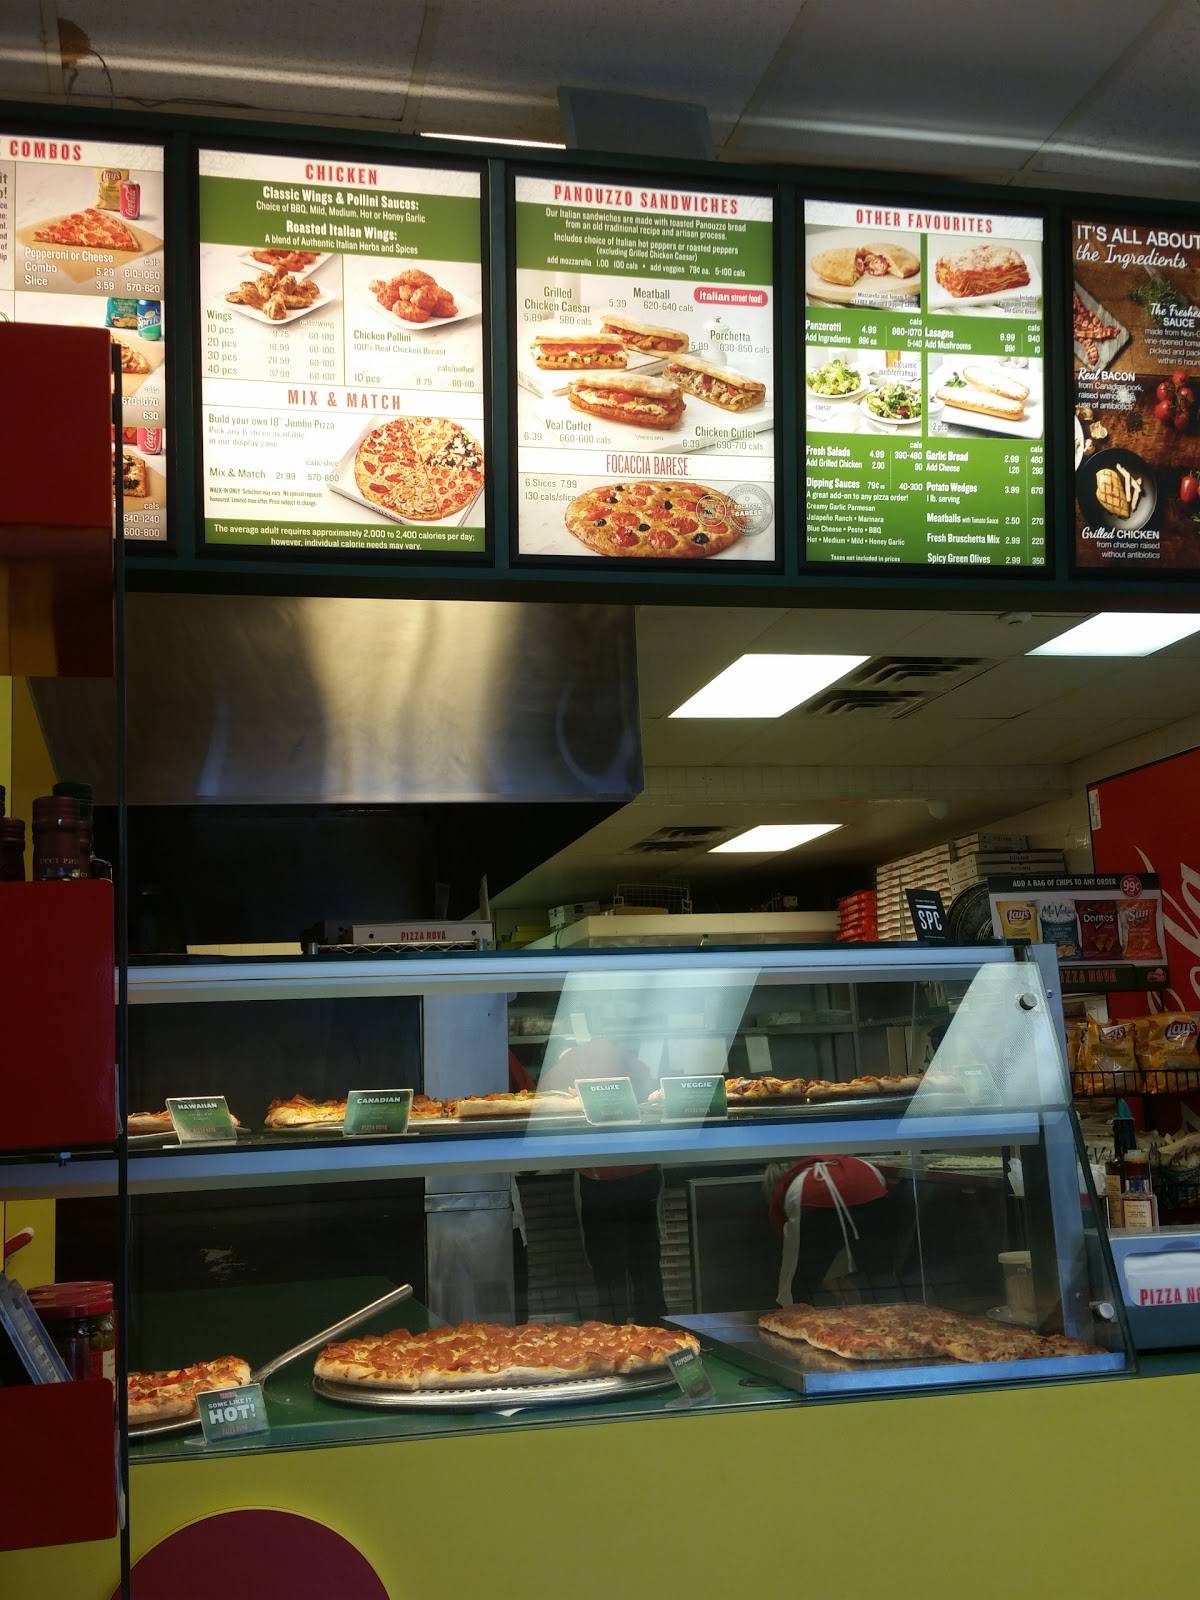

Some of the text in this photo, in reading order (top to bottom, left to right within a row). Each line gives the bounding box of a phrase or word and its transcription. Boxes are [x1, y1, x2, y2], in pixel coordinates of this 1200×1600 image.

[9, 141, 82, 161] COMBOS
[305, 164, 378, 186] CHICKEN
[263, 186, 418, 210] Classic Wings & Pollini Sauces:
[554, 185, 738, 215] PANOUZZO SANDWICHES
[256, 200, 280, 211] Choice
[282, 203, 288, 211] of
[290, 204, 308, 214] BBQ,
[310, 205, 327, 215] Mild,
[329, 206, 358, 218] Medium,
[360, 209, 372, 218] Hot
[382, 210, 404, 223] Honey
[406, 212, 425, 223] Garlic
[546, 208, 746, 231] Our Italian sandwiches are made with toasted Panouzzo bread
[856, 209, 992, 234] OTHER FAVOURITES
[286, 220, 397, 241] Roasted Italian Wings:
[566, 220, 581, 228] from
[592, 222, 603, 230] old
[604, 222, 638, 233] traditional
[640, 225, 660, 236] recipe
[662, 227, 674, 236] and
[675, 227, 698, 238] artisan
[700, 230, 727, 240] process.
[1077, 225, 1107, 241] IT'S
[1111, 228, 1142, 244] ALL
[265, 234, 418, 255] A blend of Authentic Italian Herbs and Spices
[25, 247, 113, 263] Pepperoni or Cheese
[1076, 243, 1188, 270] the Ingredients
[25, 262, 114, 277] Combo 5.29
[24, 275, 160, 293] Slice 3.59 570-620
[544, 286, 572, 298] Grilled
[633, 287, 670, 299] Meatball
[699, 290, 762, 304] Italian street food!
[525, 299, 591, 313] Chicken Caesar
[207, 310, 232, 321] Wings
[806, 320, 841, 332] Panzerotti
[1163, 318, 1195, 327] SAUCE
[354, 330, 411, 342] Chicken Pollini
[710, 329, 750, 341] Porchetta
[925, 327, 954, 339] Lasagna
[1078, 368, 1135, 381] Real BACON
[288, 389, 400, 410] MIX & MATCH
[546, 419, 591, 431] Veal Cutlet
[695, 426, 756, 439] Chicken Cutlet
[806, 446, 850, 457] Fresh Salads
[926, 451, 968, 462] Garlic Bread
[606, 454, 689, 476] FOCACCIA BARESE
[533, 479, 577, 488] Slices 7.99
[806, 477, 860, 489] Dipping Sauces
[927, 482, 1019, 494] Potato Wedges 3.99
[927, 513, 1020, 525] Meatballs 2.50
[214, 524, 475, 542] The average adult requires approximately 2,000 to 2,400 calories per day;
[927, 533, 946, 543] Fresh
[948, 534, 985, 544] Bruschetta
[987, 533, 1000, 544] Mix
[1082, 527, 1159, 540] Grilled CHICKEN
[271, 537, 422, 550] however, individual calorie needs may vary.
[1097, 541, 1111, 549] from
[928, 553, 990, 564] Spicy Green Olives
[918, 910, 942, 931] SPC
[1083, 914, 1114, 923] Doritos
[401, 931, 446, 940] PIZZA NOVA
[1140, 1288, 1181, 1305] PIZZA
[209, 1404, 256, 1424] HOT!
